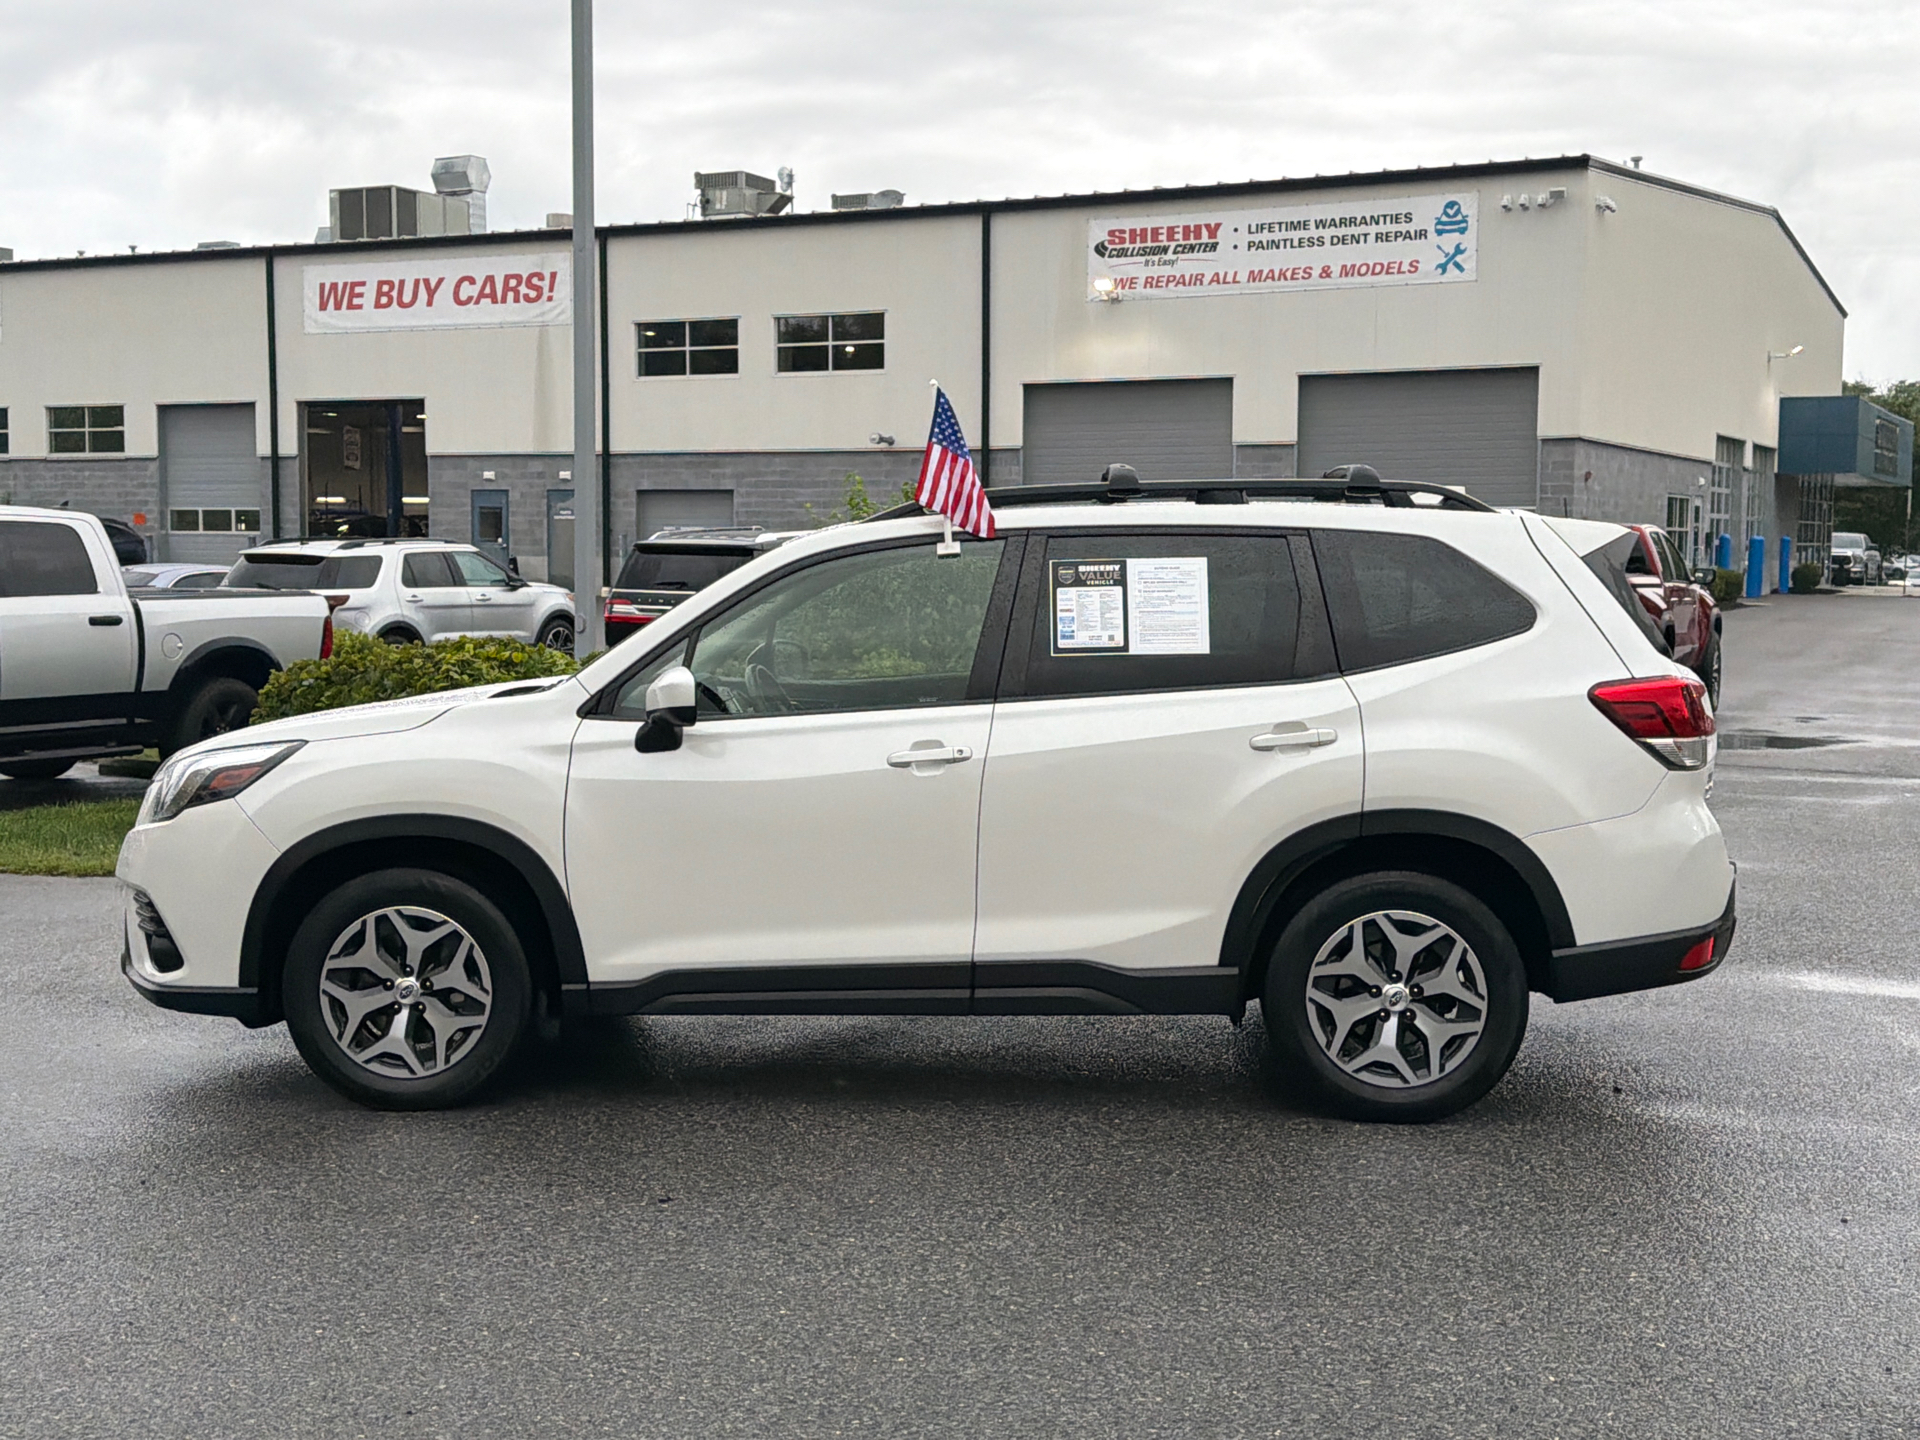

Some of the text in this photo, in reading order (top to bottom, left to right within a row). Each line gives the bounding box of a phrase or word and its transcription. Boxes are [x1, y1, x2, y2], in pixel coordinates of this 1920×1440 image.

[1107, 222, 1223, 246] SHEEHY
[1247, 211, 1413, 235] LIFETIME WARRANTIES
[1107, 241, 1219, 259] COLLISION CENTER
[1247, 228, 1428, 252] PAINTLESS DENT REPAIR
[1144, 256, 1180, 268] It's Easy!
[1113, 259, 1420, 291] WE REPAIR ALL MAKES & MODELS
[318, 271, 558, 312] WE BUY CARS!
[1079, 571, 1121, 580] VALUE
